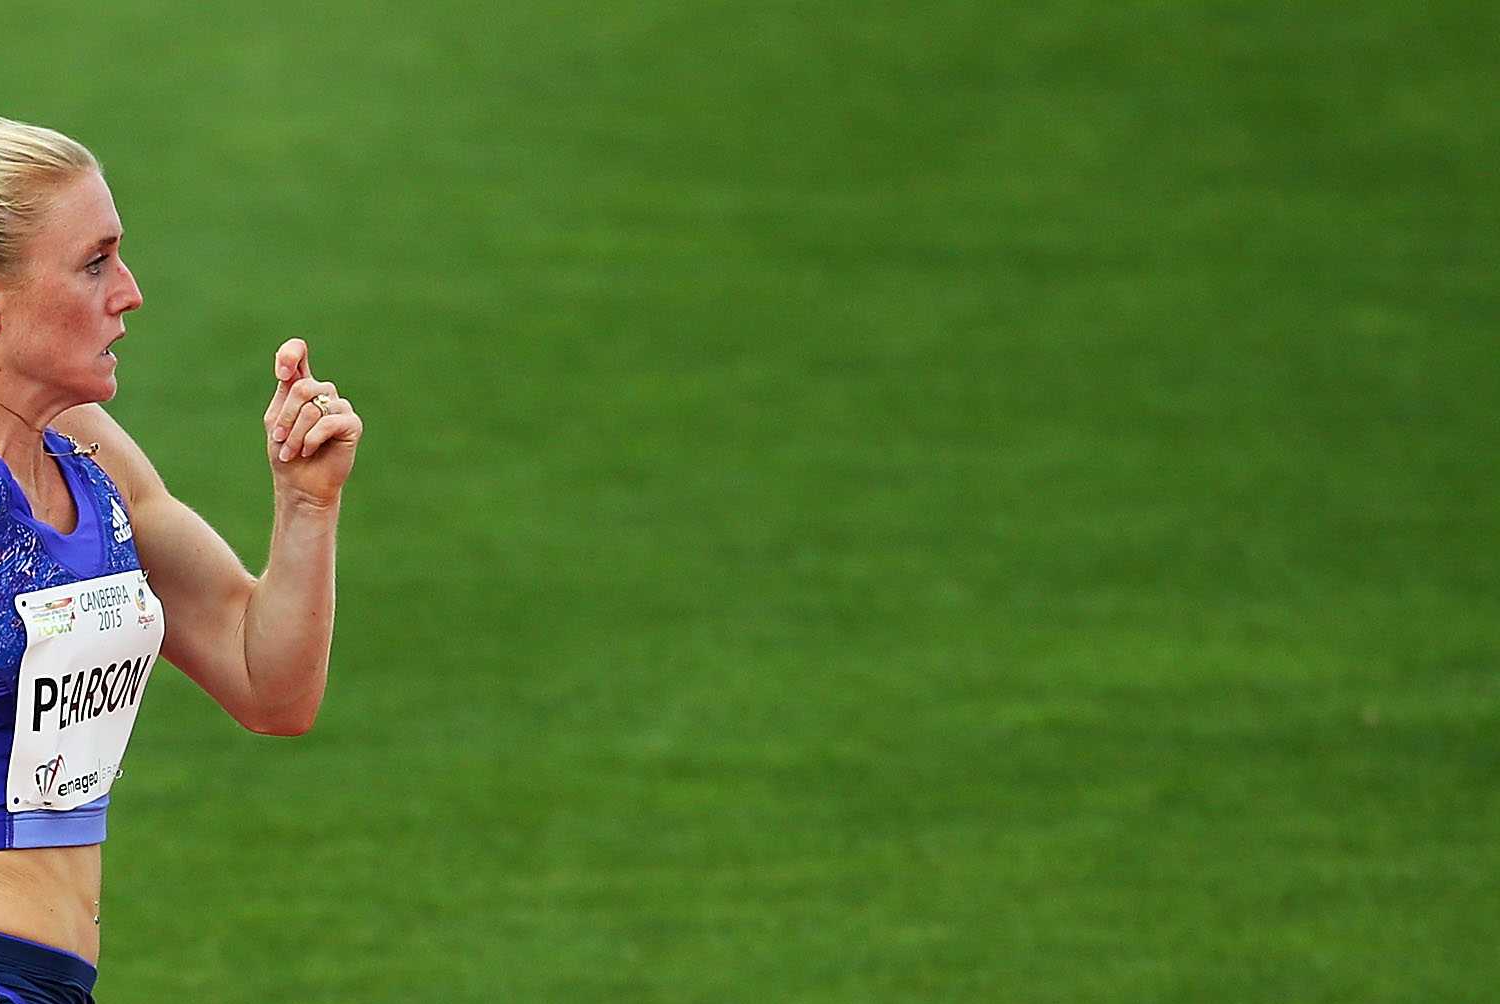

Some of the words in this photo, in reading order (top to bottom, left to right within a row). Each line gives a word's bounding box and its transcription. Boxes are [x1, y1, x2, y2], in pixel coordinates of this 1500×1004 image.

[79, 584, 131, 612] CANBERRA
[98, 608, 122, 631] 2015
[32, 654, 151, 732] PEARSON
